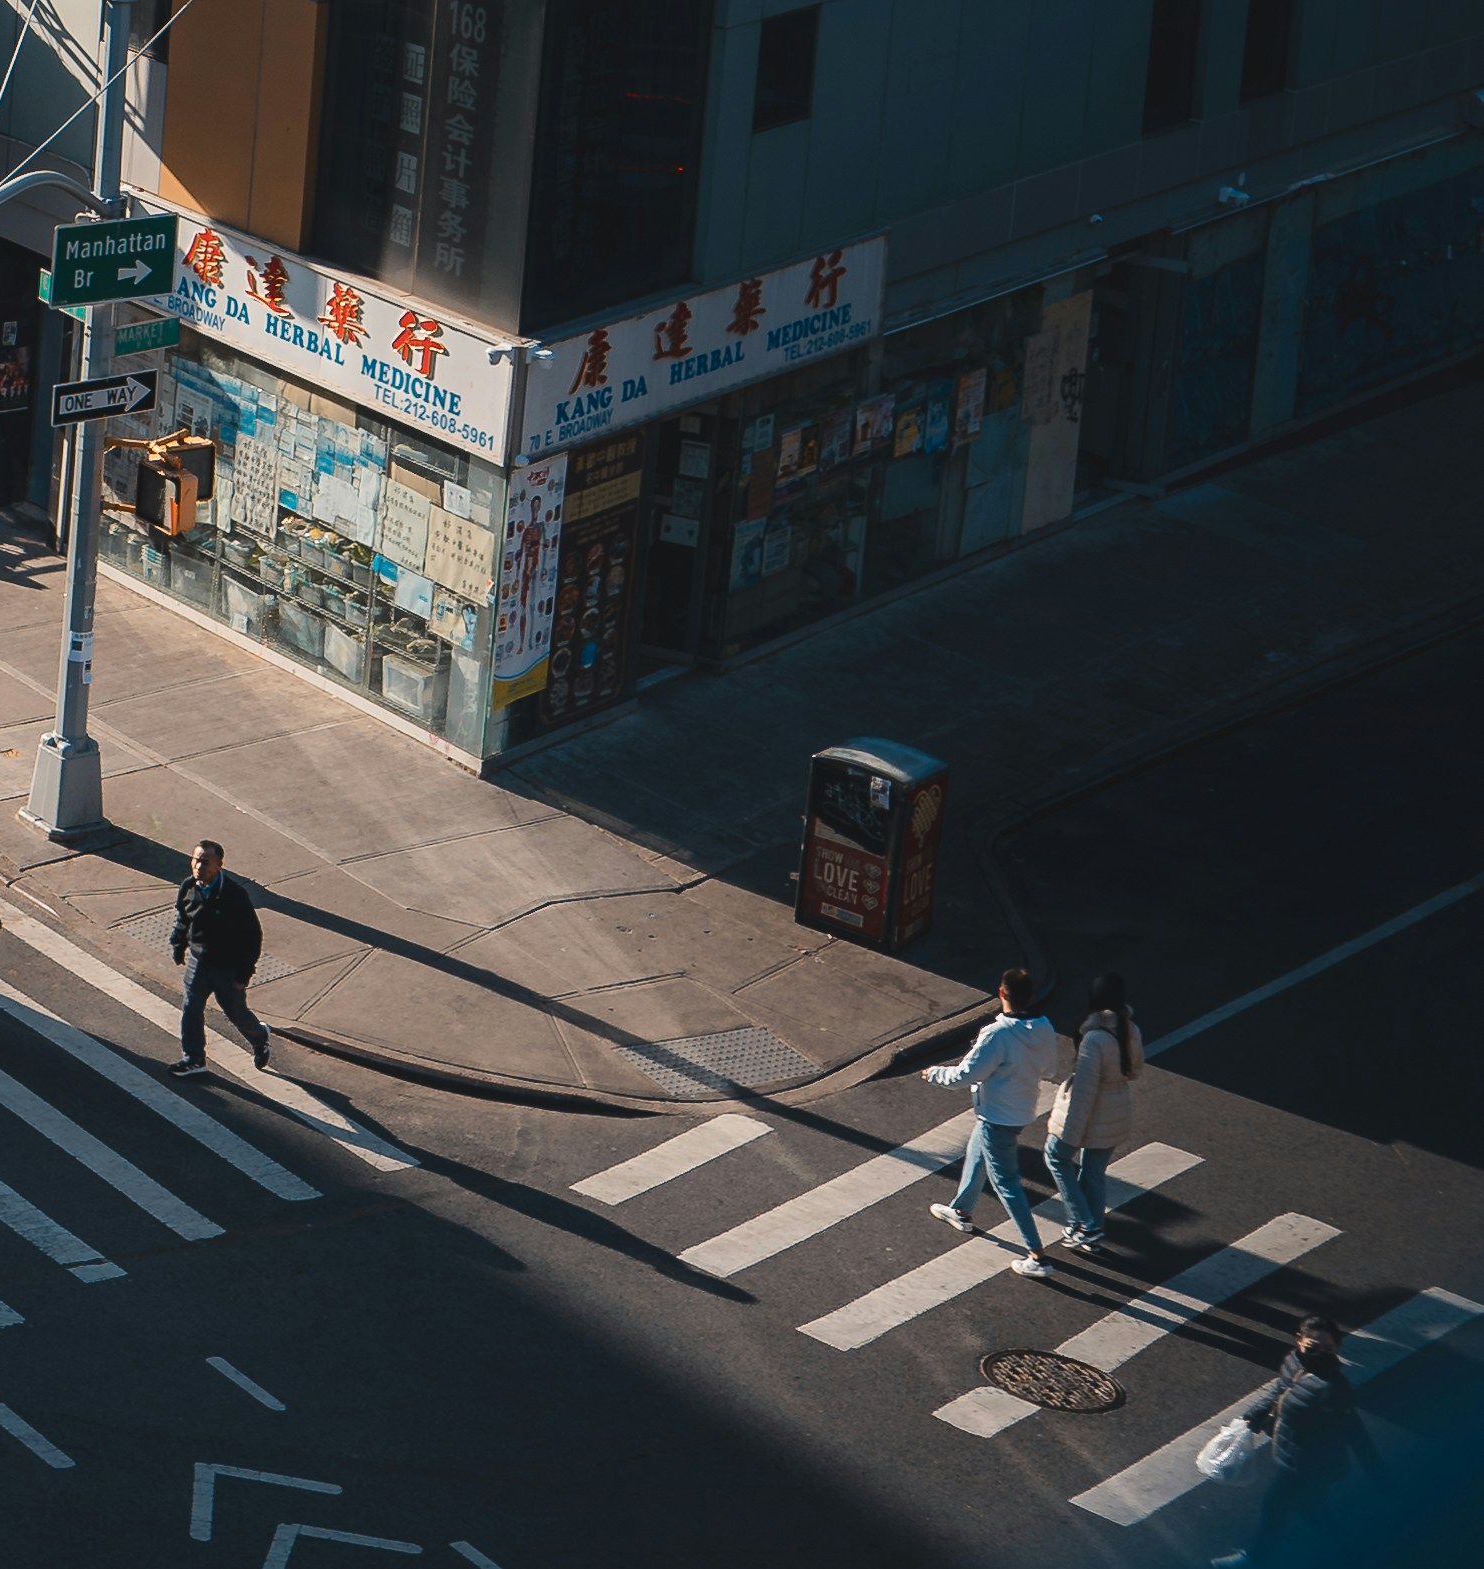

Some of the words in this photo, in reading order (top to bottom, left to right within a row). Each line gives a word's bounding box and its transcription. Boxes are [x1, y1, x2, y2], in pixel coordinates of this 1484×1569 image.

[450, 0, 487, 44] 168
[433, 43, 481, 277] 保险会计事务所
[66, 233, 166, 260] Manhattan
[74, 269, 94, 289] Br
[167, 295, 226, 332] BROADWAY
[182, 228, 451, 381] 康達藥行
[568, 250, 848, 395] 康達藥行
[118, 322, 164, 344] MARKET
[176, 276, 217, 309] ANG
[226, 294, 250, 325] DA
[266, 315, 346, 366] HERBAL
[361, 354, 462, 417] MEDICINE
[555, 386, 614, 426] KANG
[621, 375, 649, 404] DA
[669, 341, 746, 385] HERBAL
[766, 303, 853, 352] MEDICINE
[65, 393, 94, 412] ONE
[107, 386, 138, 405] WAY
[374, 383, 495, 452] TEL:212-608-5961
[530, 435, 540, 451] 70
[558, 408, 614, 442] BROADWAY
[813, 857, 861, 893] LOVE
